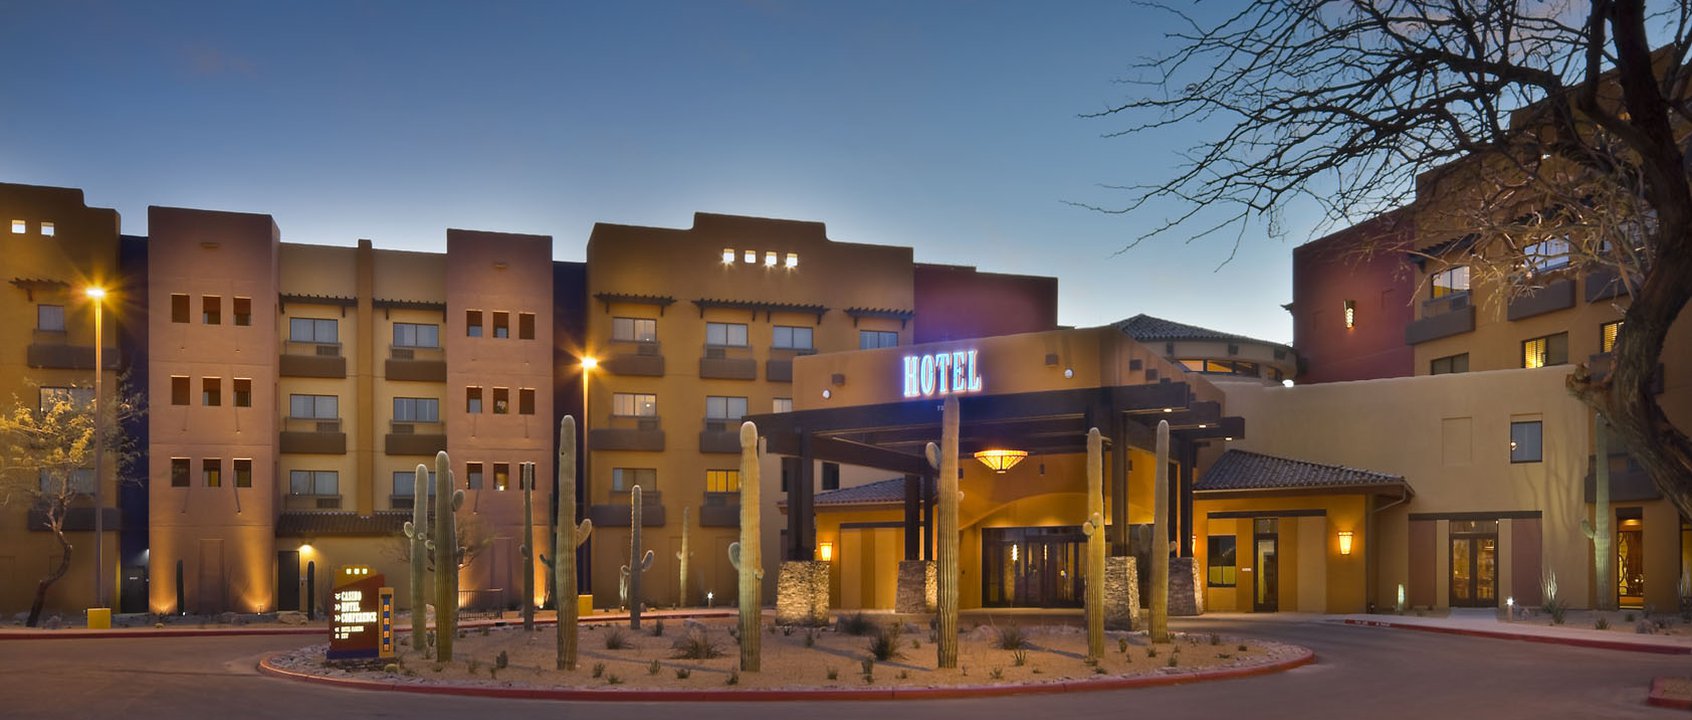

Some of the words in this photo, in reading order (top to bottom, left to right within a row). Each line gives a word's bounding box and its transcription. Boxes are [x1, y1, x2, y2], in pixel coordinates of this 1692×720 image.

[904, 350, 982, 397] HOTEL
[341, 591, 362, 601] CASINO
[341, 602, 360, 612] HOTEL
[341, 612, 377, 623] CONFERENCE
